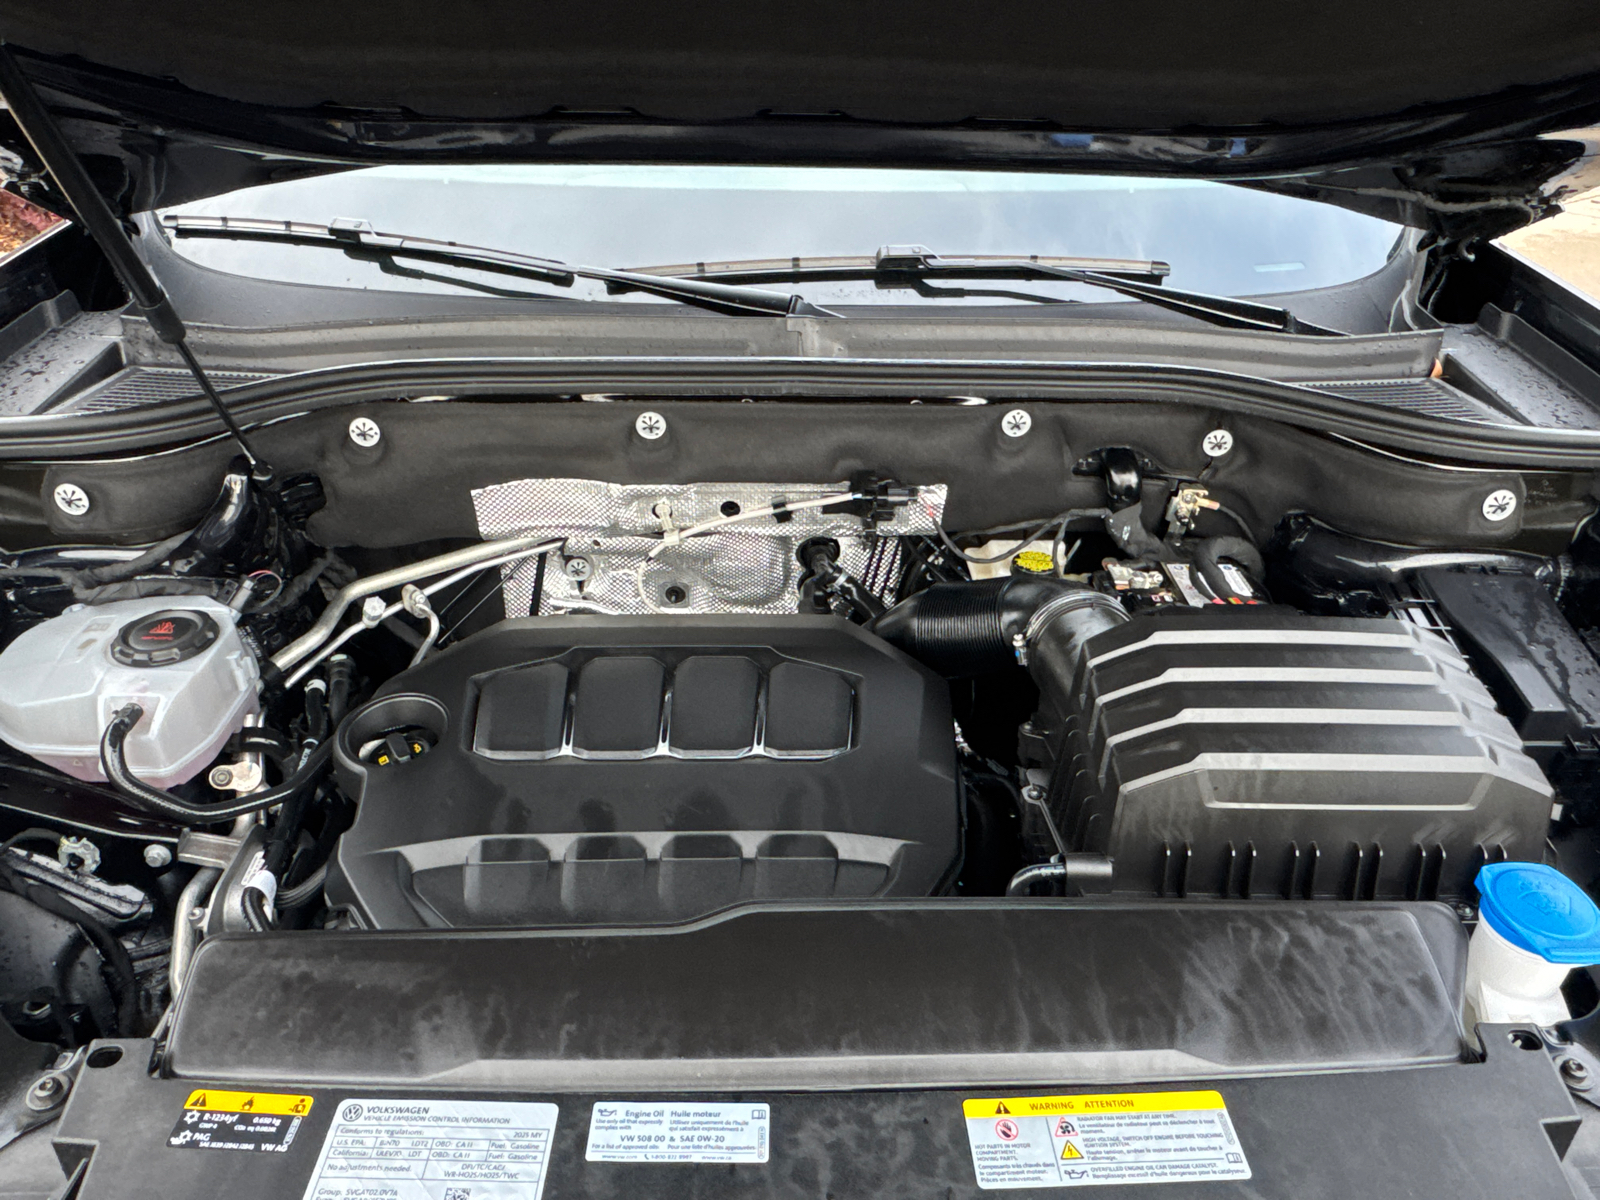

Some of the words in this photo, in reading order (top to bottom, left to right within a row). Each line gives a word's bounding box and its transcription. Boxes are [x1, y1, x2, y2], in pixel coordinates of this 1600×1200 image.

[1029, 1101, 1074, 1110] WARNING
[1084, 1100, 1134, 1108] ATTENTION
[367, 1106, 430, 1114] VOLKSWAGEN
[625, 1110, 651, 1118] Engine
[203, 1113, 240, 1124] R-1234yf
[340, 1127, 373, 1135] Conforms
[375, 1127, 382, 1135] to
[192, 1132, 211, 1141] PAG
[261, 1143, 275, 1151] VW
[275, 1144, 288, 1152] AG
[338, 1164, 383, 1172] adjustments
